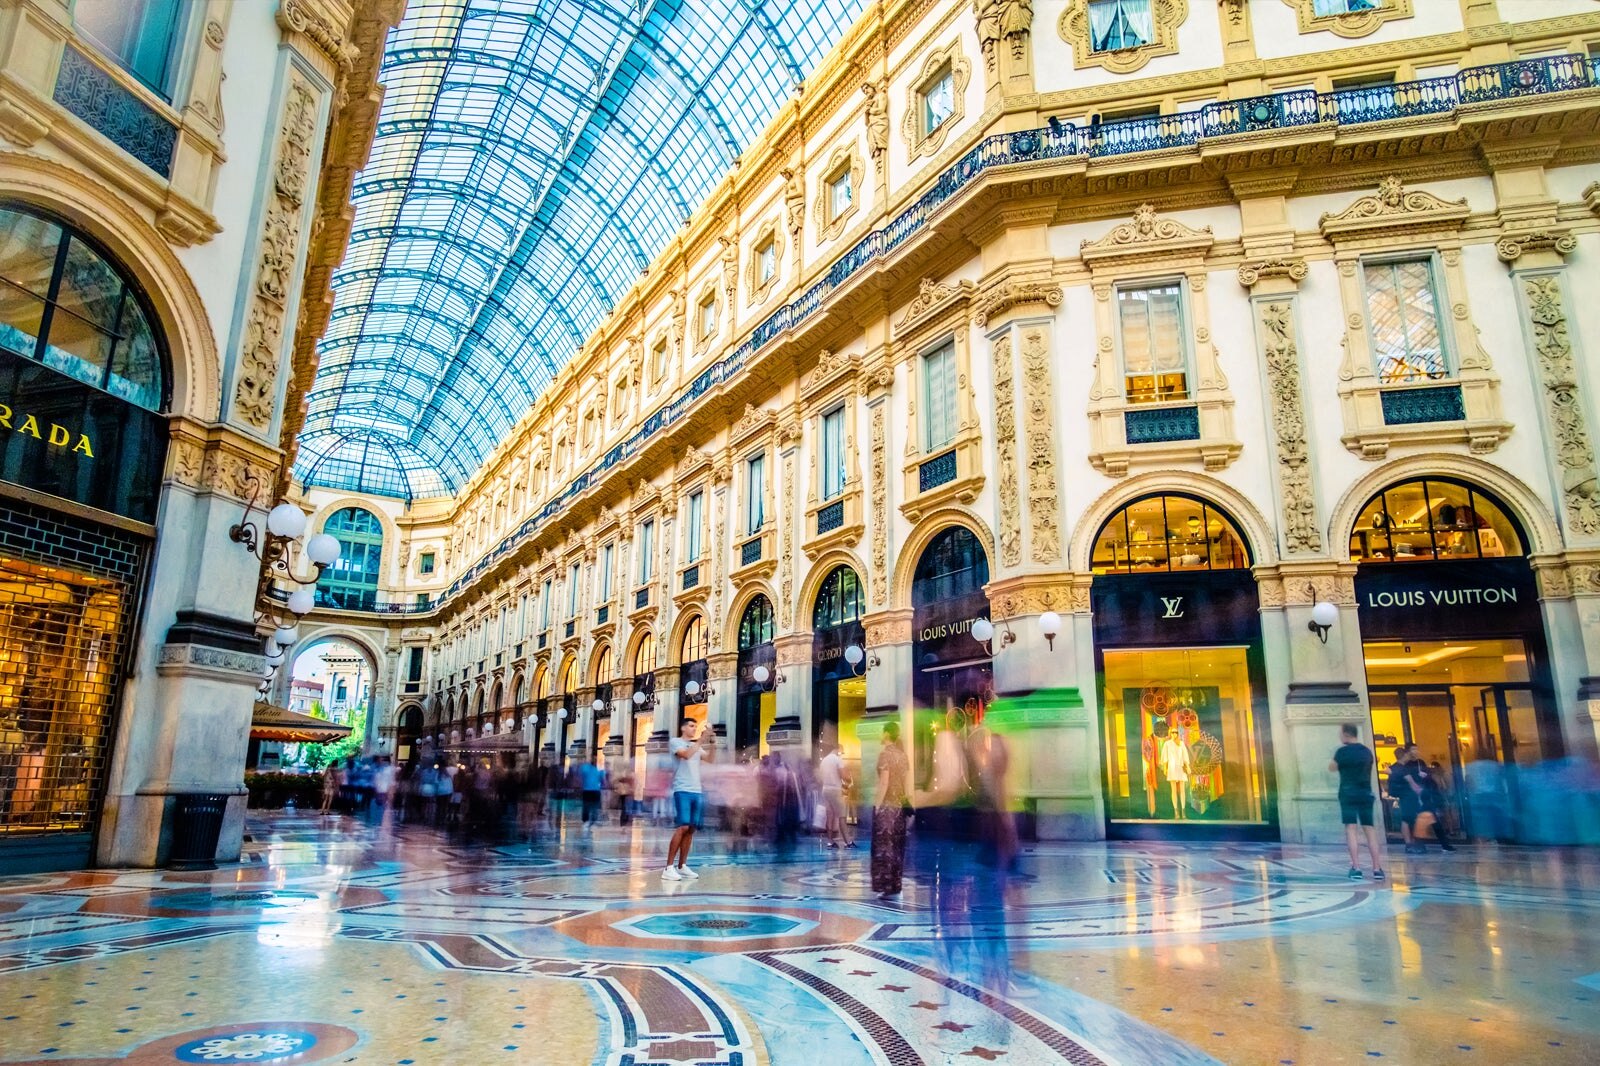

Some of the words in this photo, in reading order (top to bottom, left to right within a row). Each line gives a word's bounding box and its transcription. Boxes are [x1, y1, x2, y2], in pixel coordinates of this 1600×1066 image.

[1369, 591, 1425, 607] LOUIS
[1430, 588, 1517, 605] VUITTON
[920, 625, 947, 641] LOUIS
